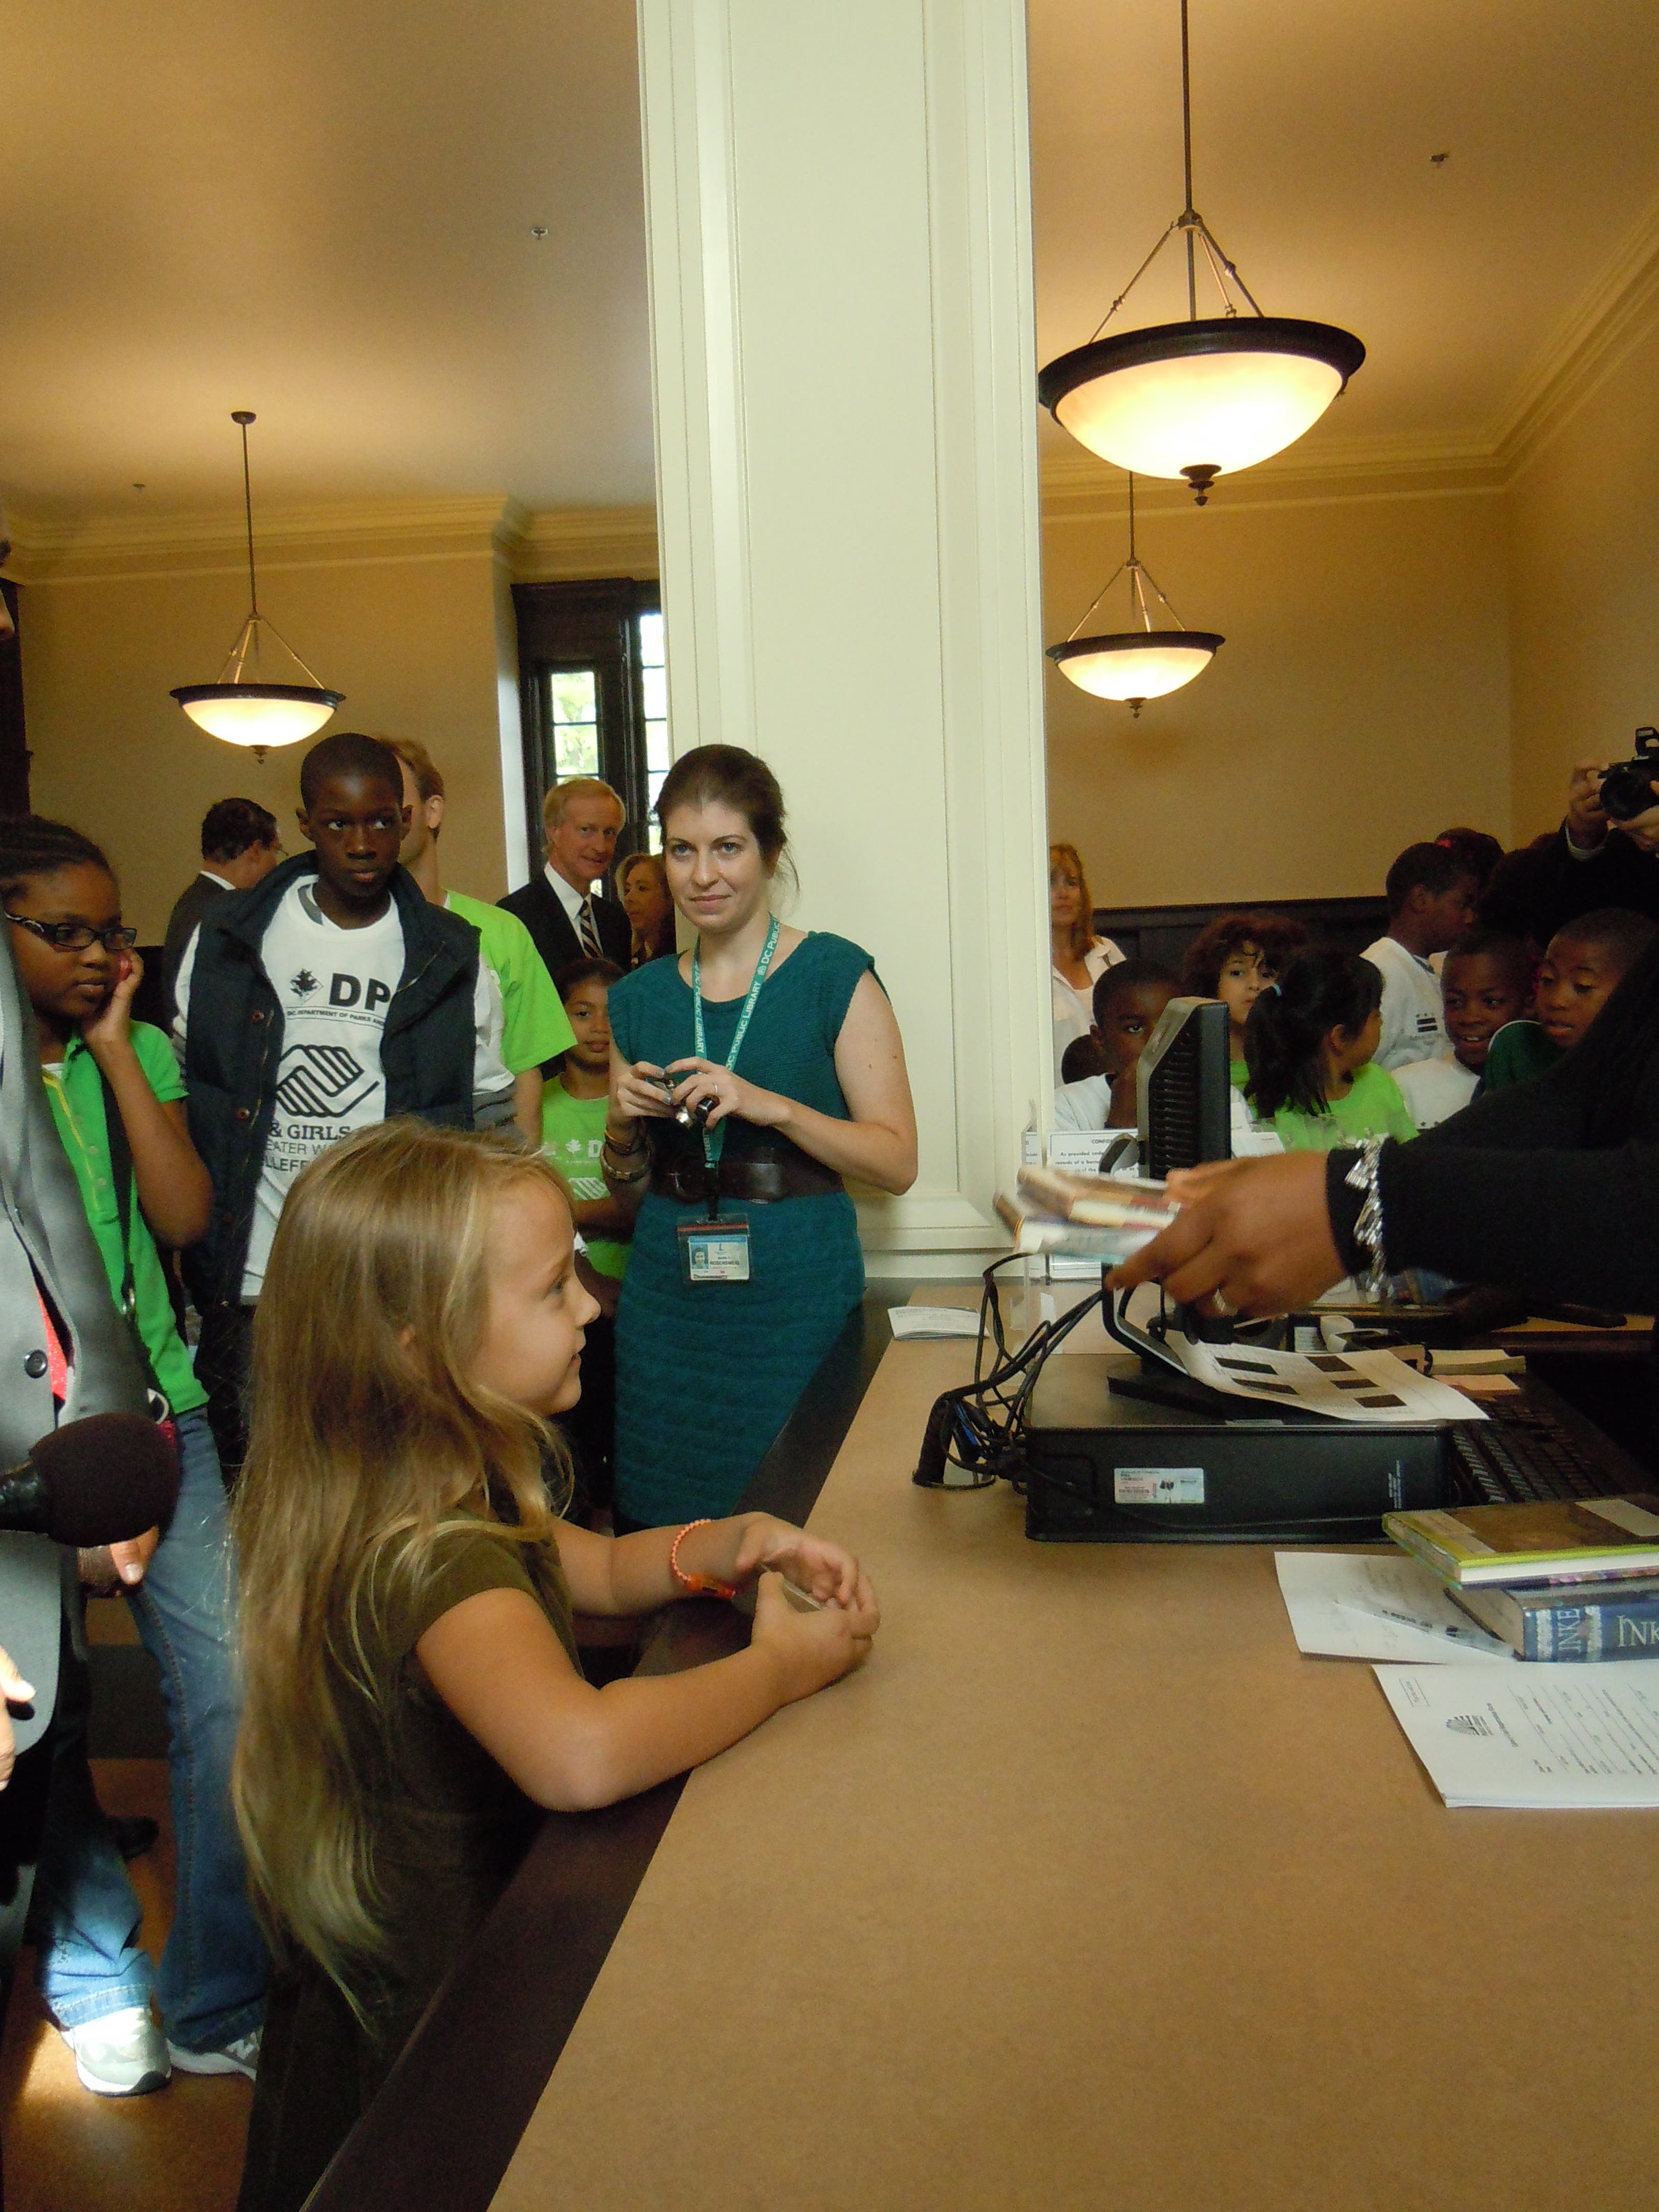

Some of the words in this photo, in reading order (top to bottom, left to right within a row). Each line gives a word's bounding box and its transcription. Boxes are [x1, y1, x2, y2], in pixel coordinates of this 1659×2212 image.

[761, 949, 773, 964] DC
[767, 922, 780, 949] PUBLIC
[329, 972, 391, 1011] DP
[349, 1014, 371, 1022] PARKS
[696, 1016, 704, 1053] LIBRARY
[726, 1055, 735, 1071] DC
[731, 1020, 748, 1053] PUBLIC
[742, 981, 761, 1019] LIBRARY
[287, 1124, 351, 1140] GIRLS
